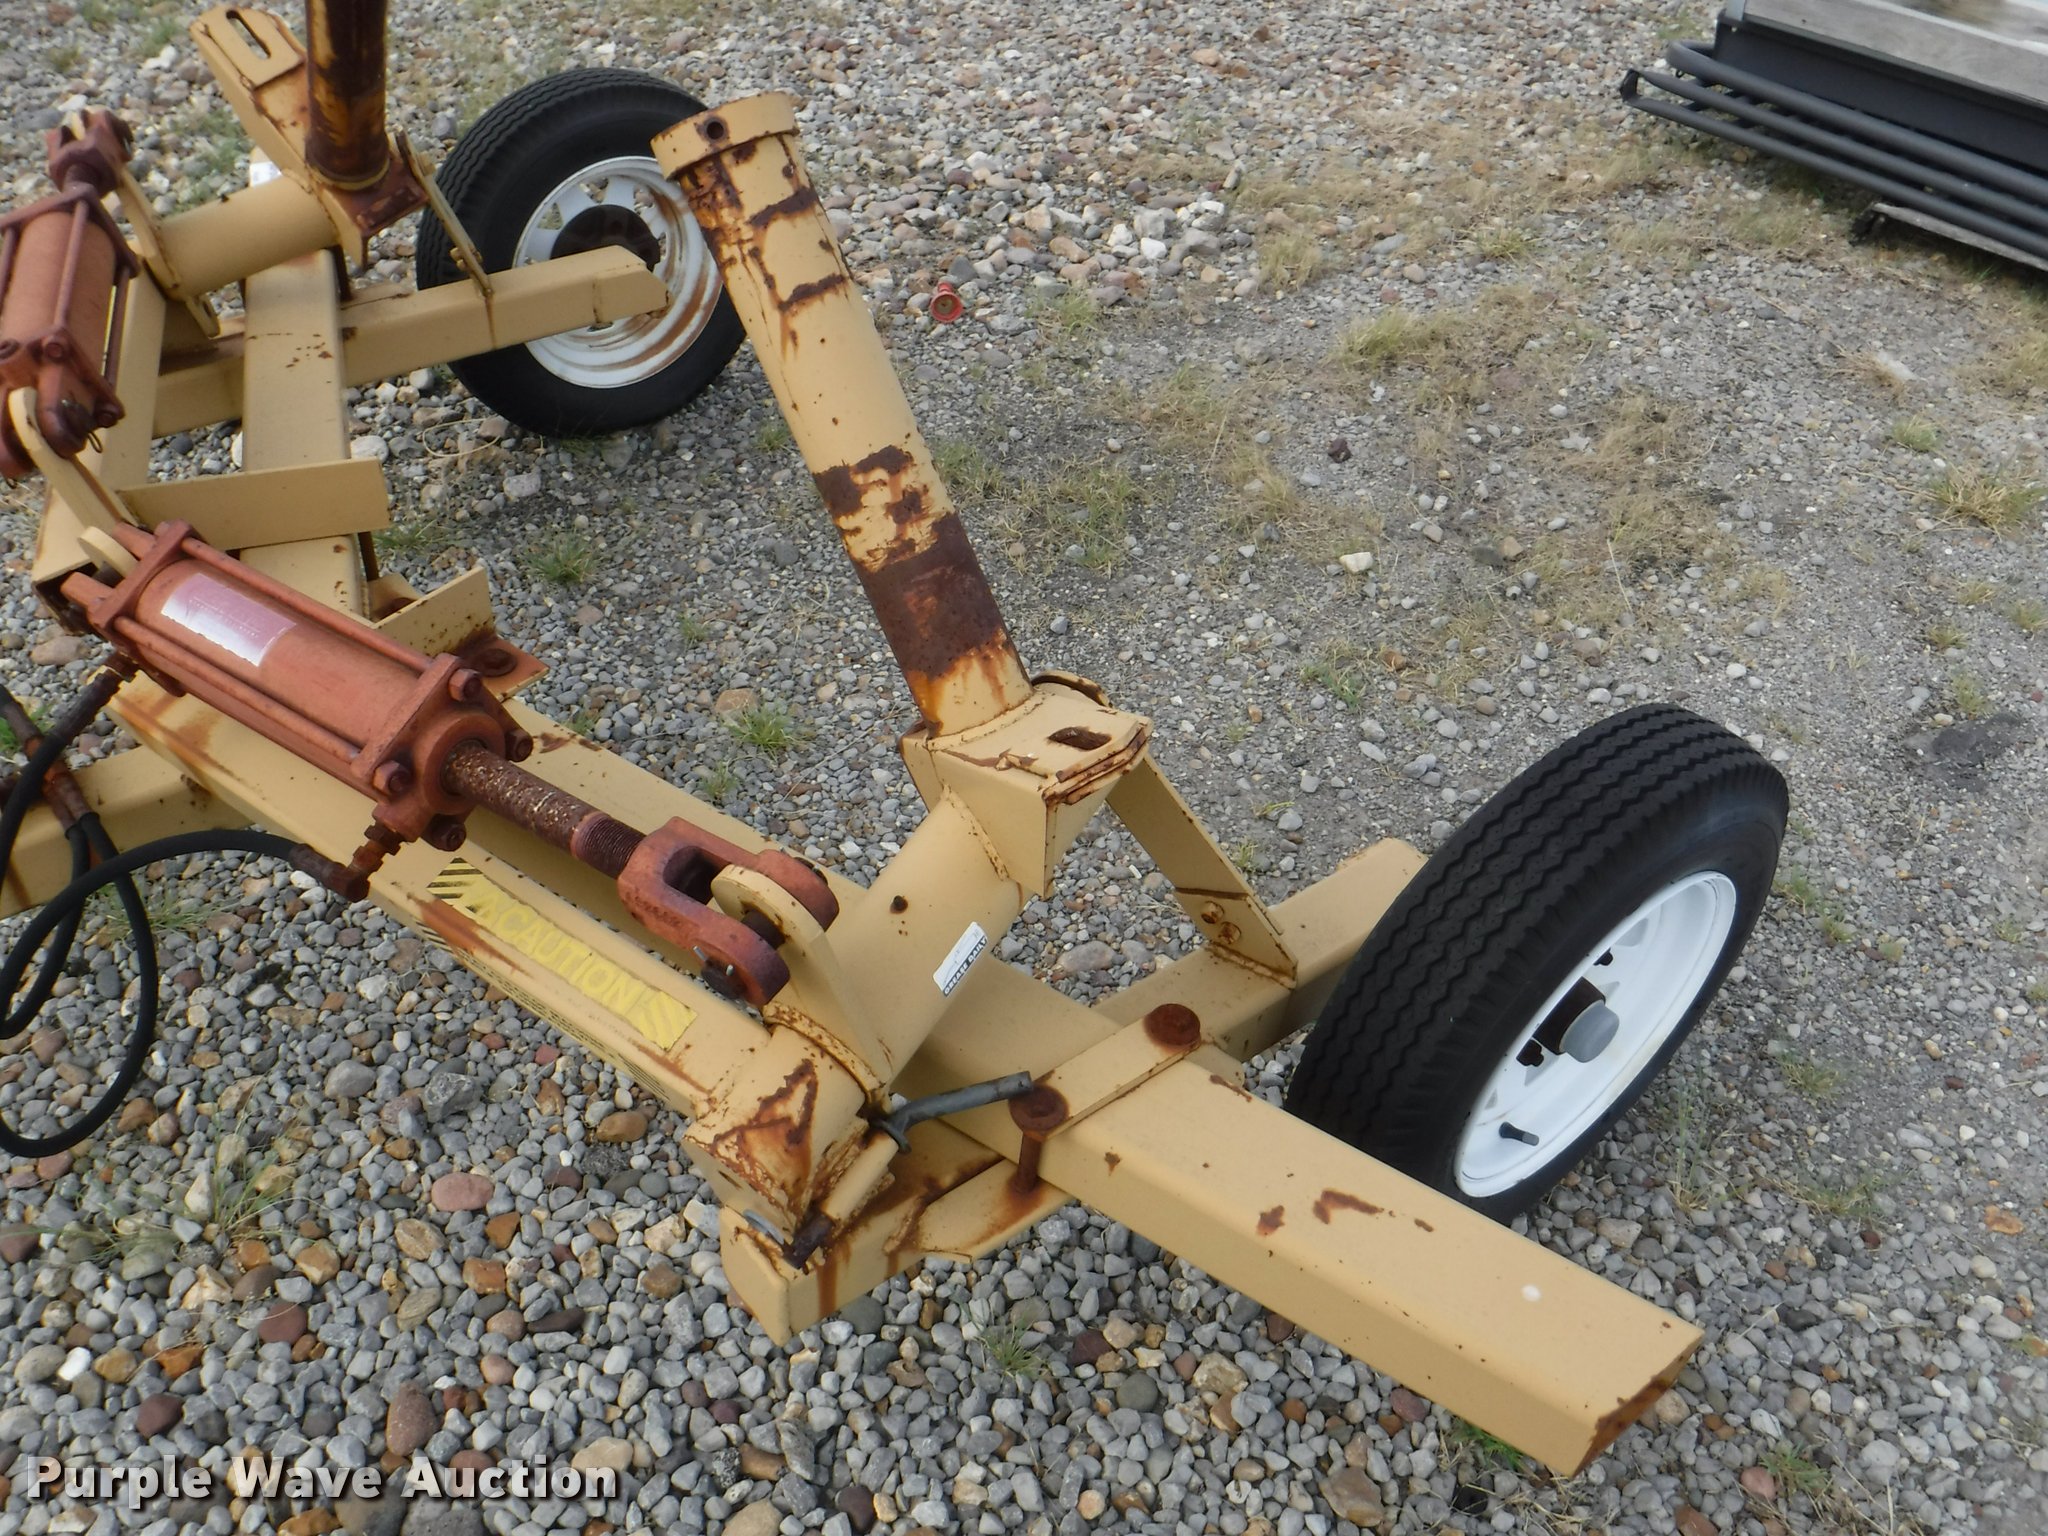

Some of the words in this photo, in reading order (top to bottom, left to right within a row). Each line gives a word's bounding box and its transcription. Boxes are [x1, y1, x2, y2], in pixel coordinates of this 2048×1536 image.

[497, 904, 643, 1014] CAUTION
[944, 961, 969, 996] GREASE
[967, 936, 987, 963] DAILY
